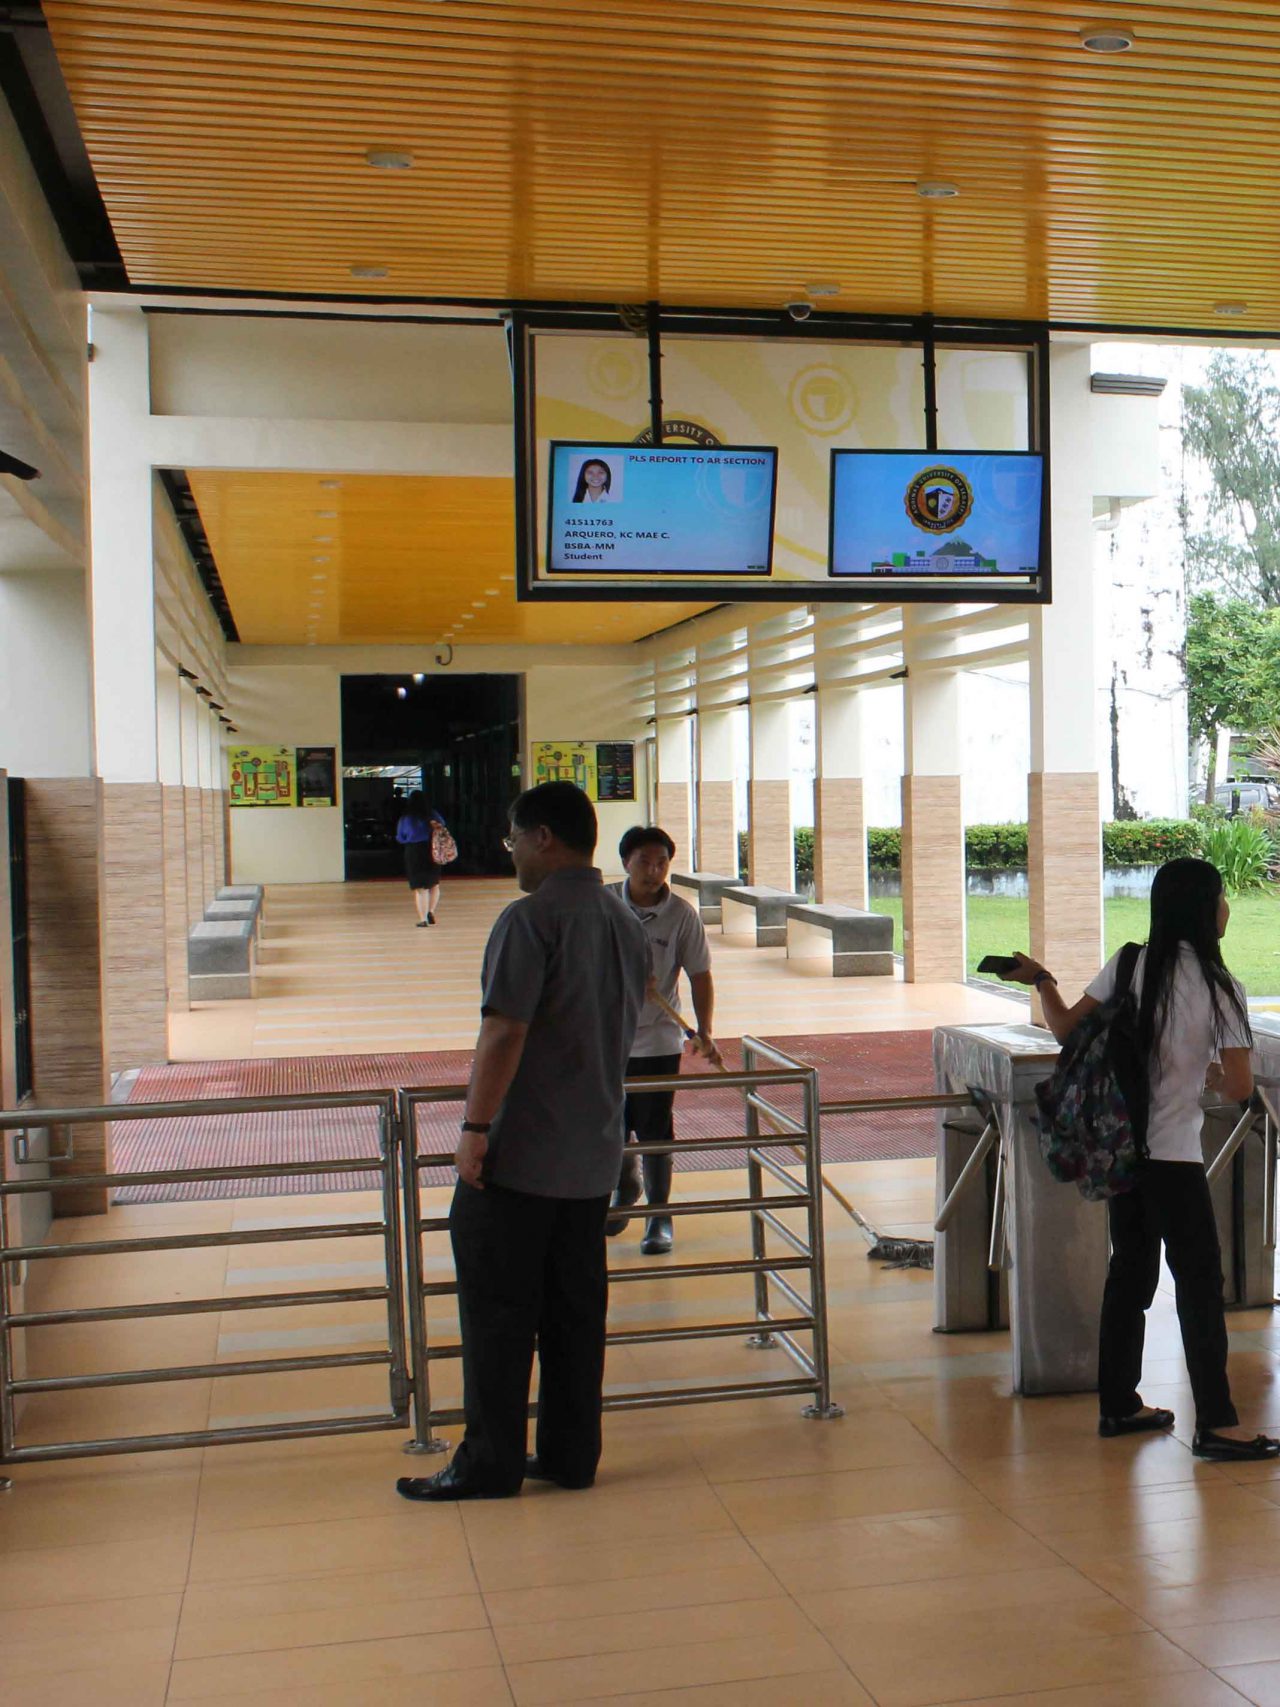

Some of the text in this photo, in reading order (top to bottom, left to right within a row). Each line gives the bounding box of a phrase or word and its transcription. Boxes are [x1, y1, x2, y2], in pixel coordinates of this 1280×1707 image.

[639, 423, 704, 445] UNERSITY
[629, 455, 647, 463] PLS
[649, 455, 688, 463] REPORT
[691, 456, 704, 464] TO
[723, 457, 766, 465] SECTION
[564, 530, 617, 539] ARQUERO,
[619, 531, 633, 539] KC
[635, 531, 658, 539] MAE
[564, 542, 615, 550] BSBA-MM
